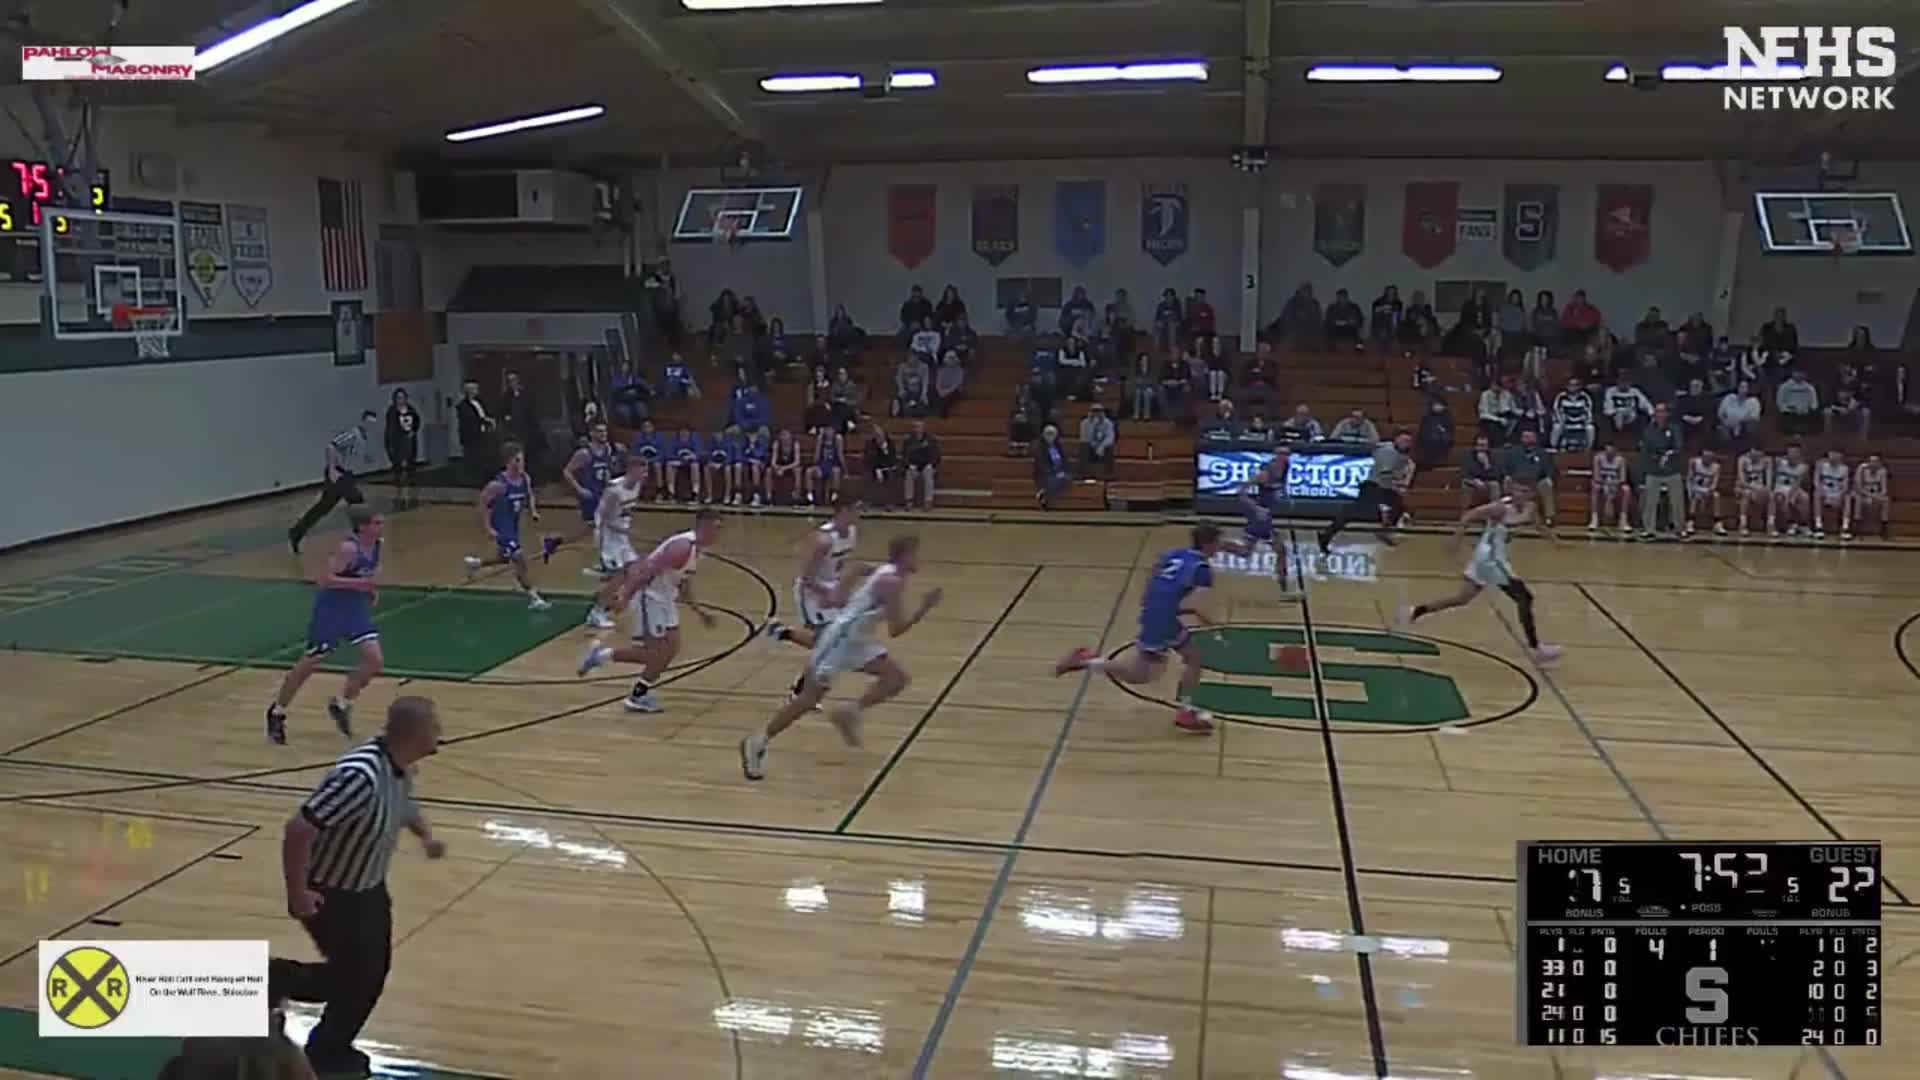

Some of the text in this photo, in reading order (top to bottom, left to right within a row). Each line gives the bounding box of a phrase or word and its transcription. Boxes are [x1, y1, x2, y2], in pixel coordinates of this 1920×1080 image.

[1515, 201, 1544, 241] S
[1245, 275, 1254, 289] 3
[1211, 461, 1371, 486] SHCTON
[1161, 558, 1185, 579] 2
